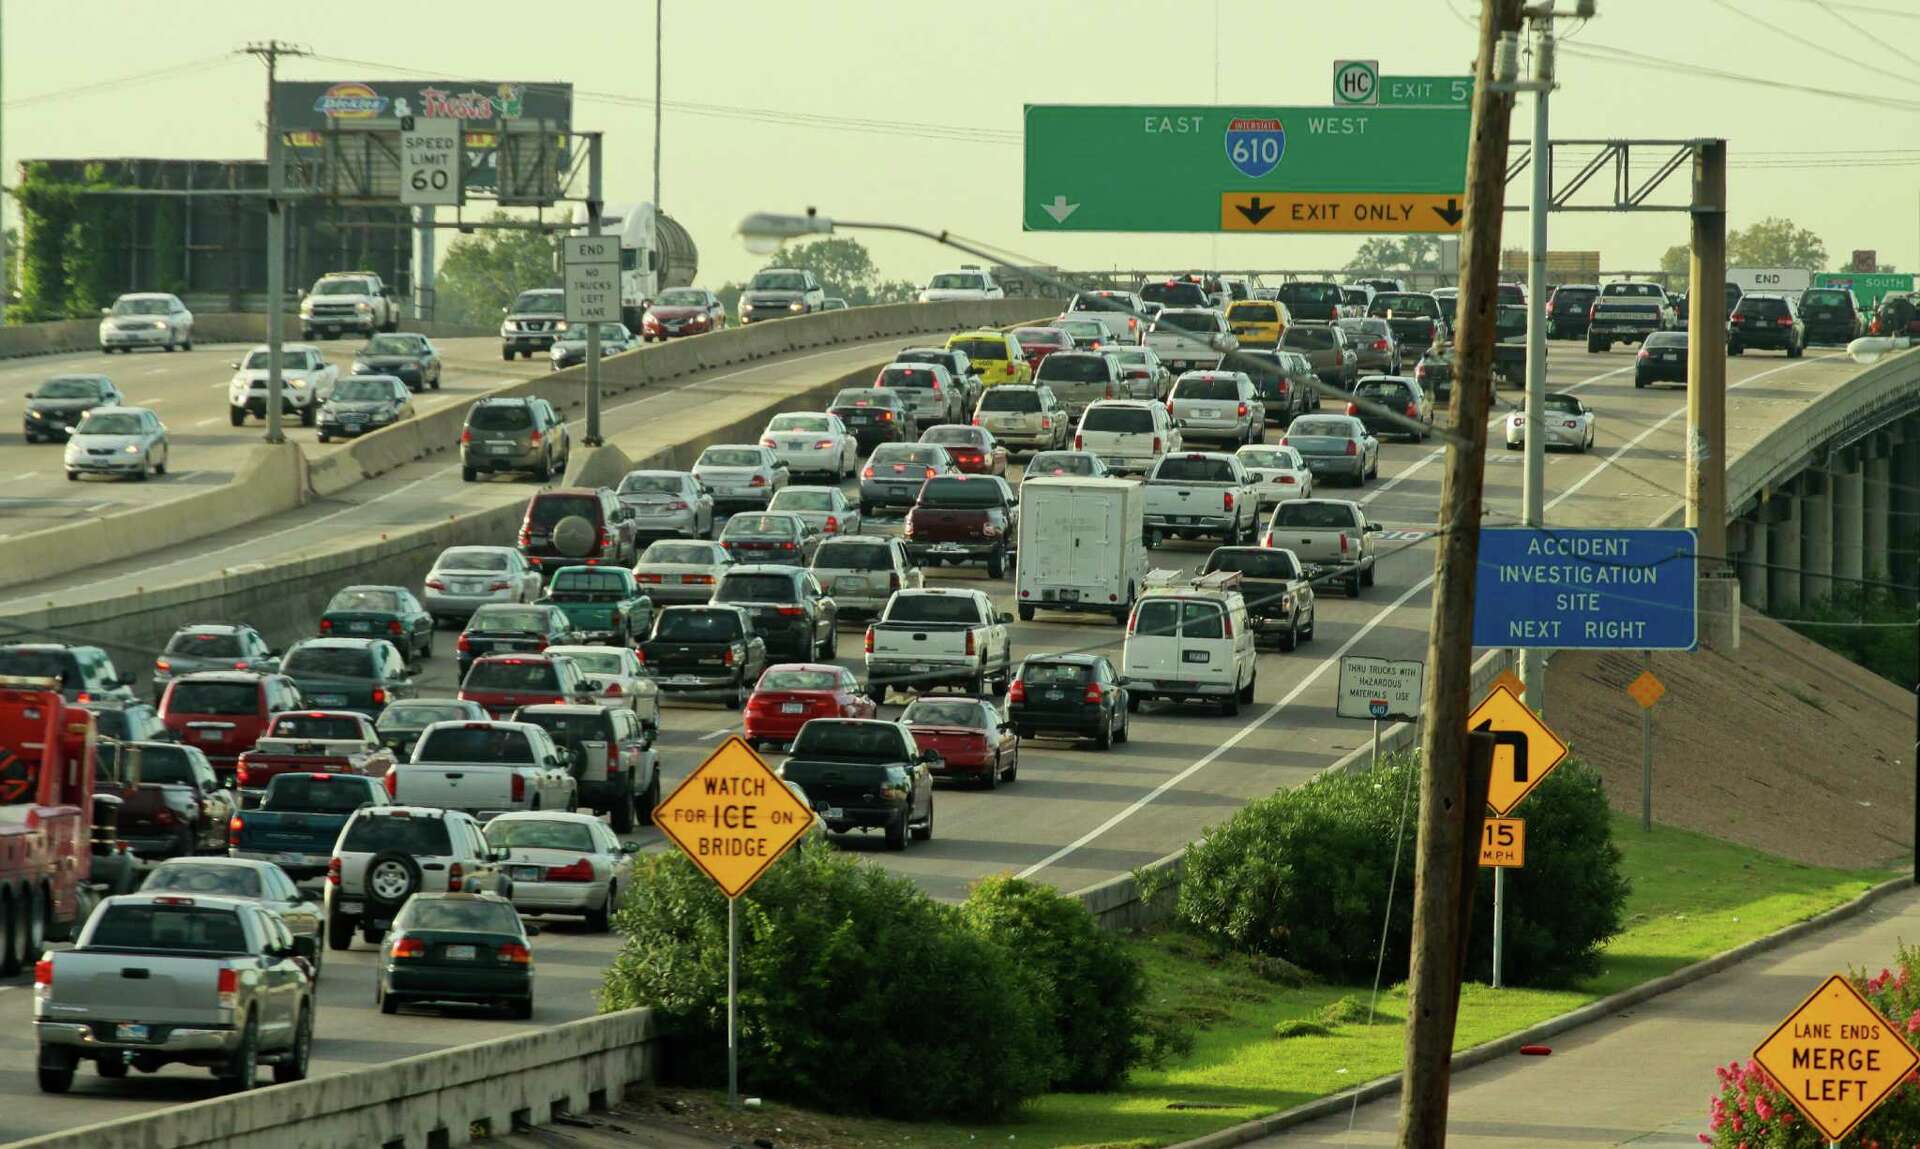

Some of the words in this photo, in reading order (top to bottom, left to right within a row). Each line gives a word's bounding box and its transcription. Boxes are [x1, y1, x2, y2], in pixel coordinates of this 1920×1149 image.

[1343, 72, 1369, 93] HC
[1392, 83, 1432, 98] EXIT
[1145, 116, 1203, 133] EAST
[1308, 117, 1369, 134] WEST
[405, 137, 454, 150] SPEED
[1232, 137, 1279, 164] 610
[410, 152, 450, 165] LIMIT
[411, 169, 449, 191] 60
[1291, 203, 1340, 221] EXIT
[1354, 204, 1414, 222] ONLY
[579, 244, 604, 256] END
[585, 267, 599, 277] NO
[1754, 274, 1781, 285] END
[574, 281, 612, 290] TRUCKS
[1864, 277, 1905, 288] SOUTH
[580, 294, 604, 304] LEFT
[580, 307, 605, 317] LANE
[1527, 537, 1630, 556] ACCIDENT
[1500, 565, 1658, 584] INVESTIGATION
[1556, 593, 1601, 611] SITE
[1509, 620, 1562, 638] NEXT
[1585, 621, 1647, 639] RIGHT
[1348, 664, 1366, 673] THRU
[1369, 665, 1396, 675] TRUCKS
[1400, 668, 1416, 677] WITH
[1359, 677, 1402, 689] HAZARDOUS
[1349, 689, 1387, 699] MATERIALS
[1395, 692, 1409, 701] USE
[1371, 705, 1385, 714] 610
[704, 777, 766, 797] WATCH
[674, 808, 706, 823] FOR
[713, 804, 758, 829] ICE
[770, 810, 793, 825] ON
[1485, 824, 1514, 847] 15
[698, 837, 768, 857] BRIDGE
[1794, 1023, 1832, 1039] LANE
[1840, 1024, 1880, 1040] ENDS
[1792, 1047, 1881, 1072] MERGE
[1805, 1079, 1868, 1102] LEFT
